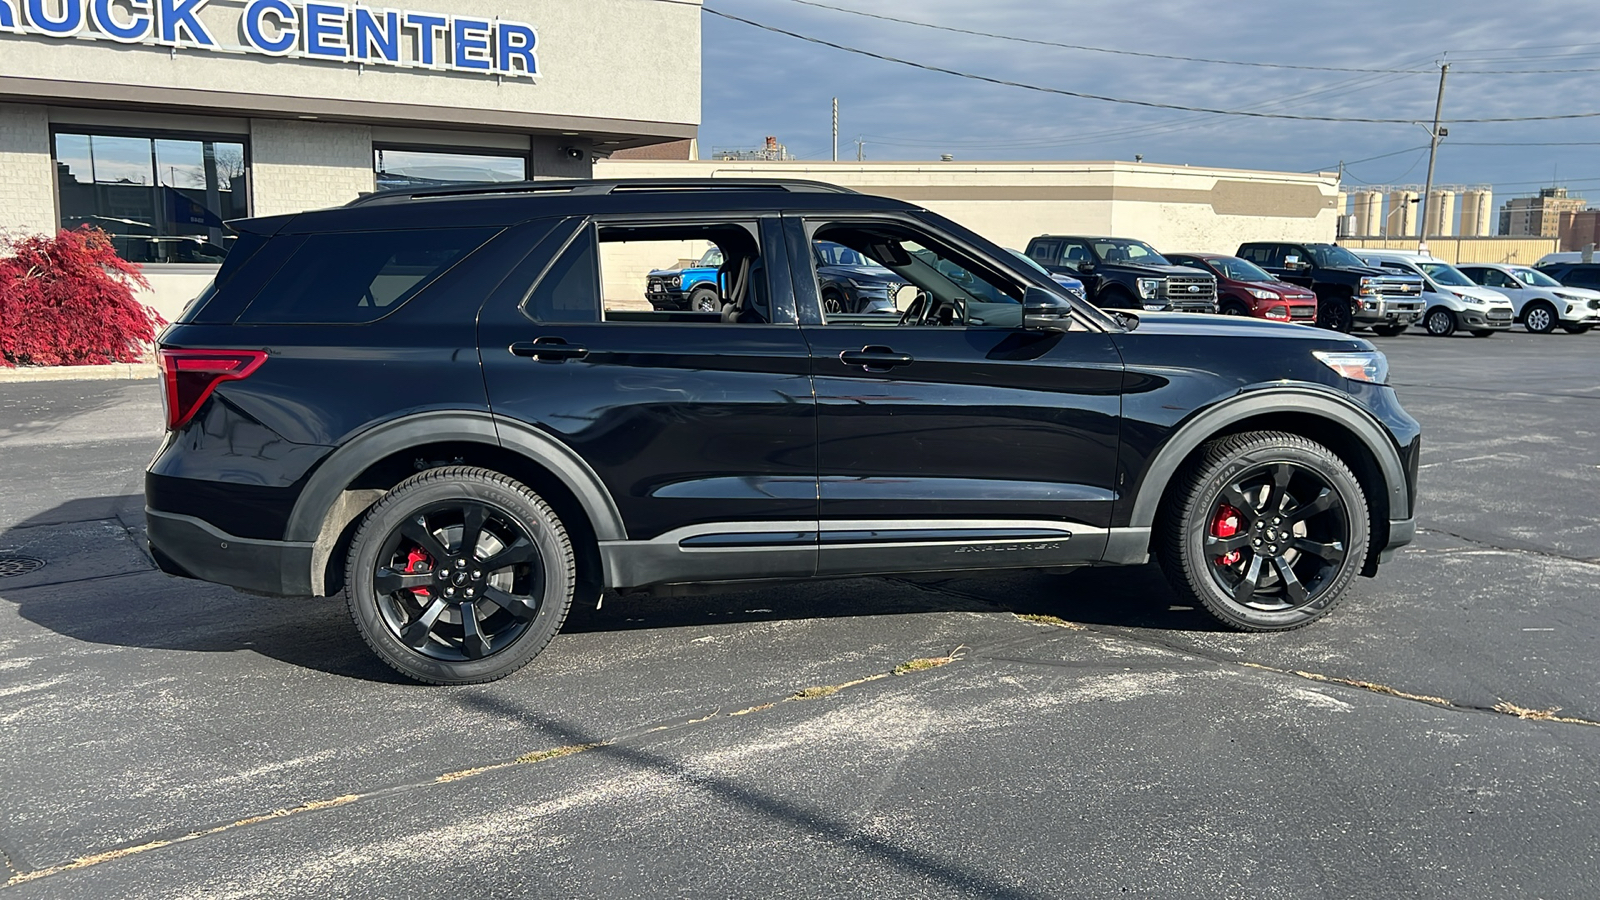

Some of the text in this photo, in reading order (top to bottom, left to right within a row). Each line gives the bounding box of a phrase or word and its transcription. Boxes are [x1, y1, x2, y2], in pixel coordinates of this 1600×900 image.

[242, 0, 543, 78] CENTER
[482, 490, 538, 527] ASSURANCE
[1199, 466, 1236, 514] GOODYEAR
[1318, 559, 1355, 608] ASSURANCE
